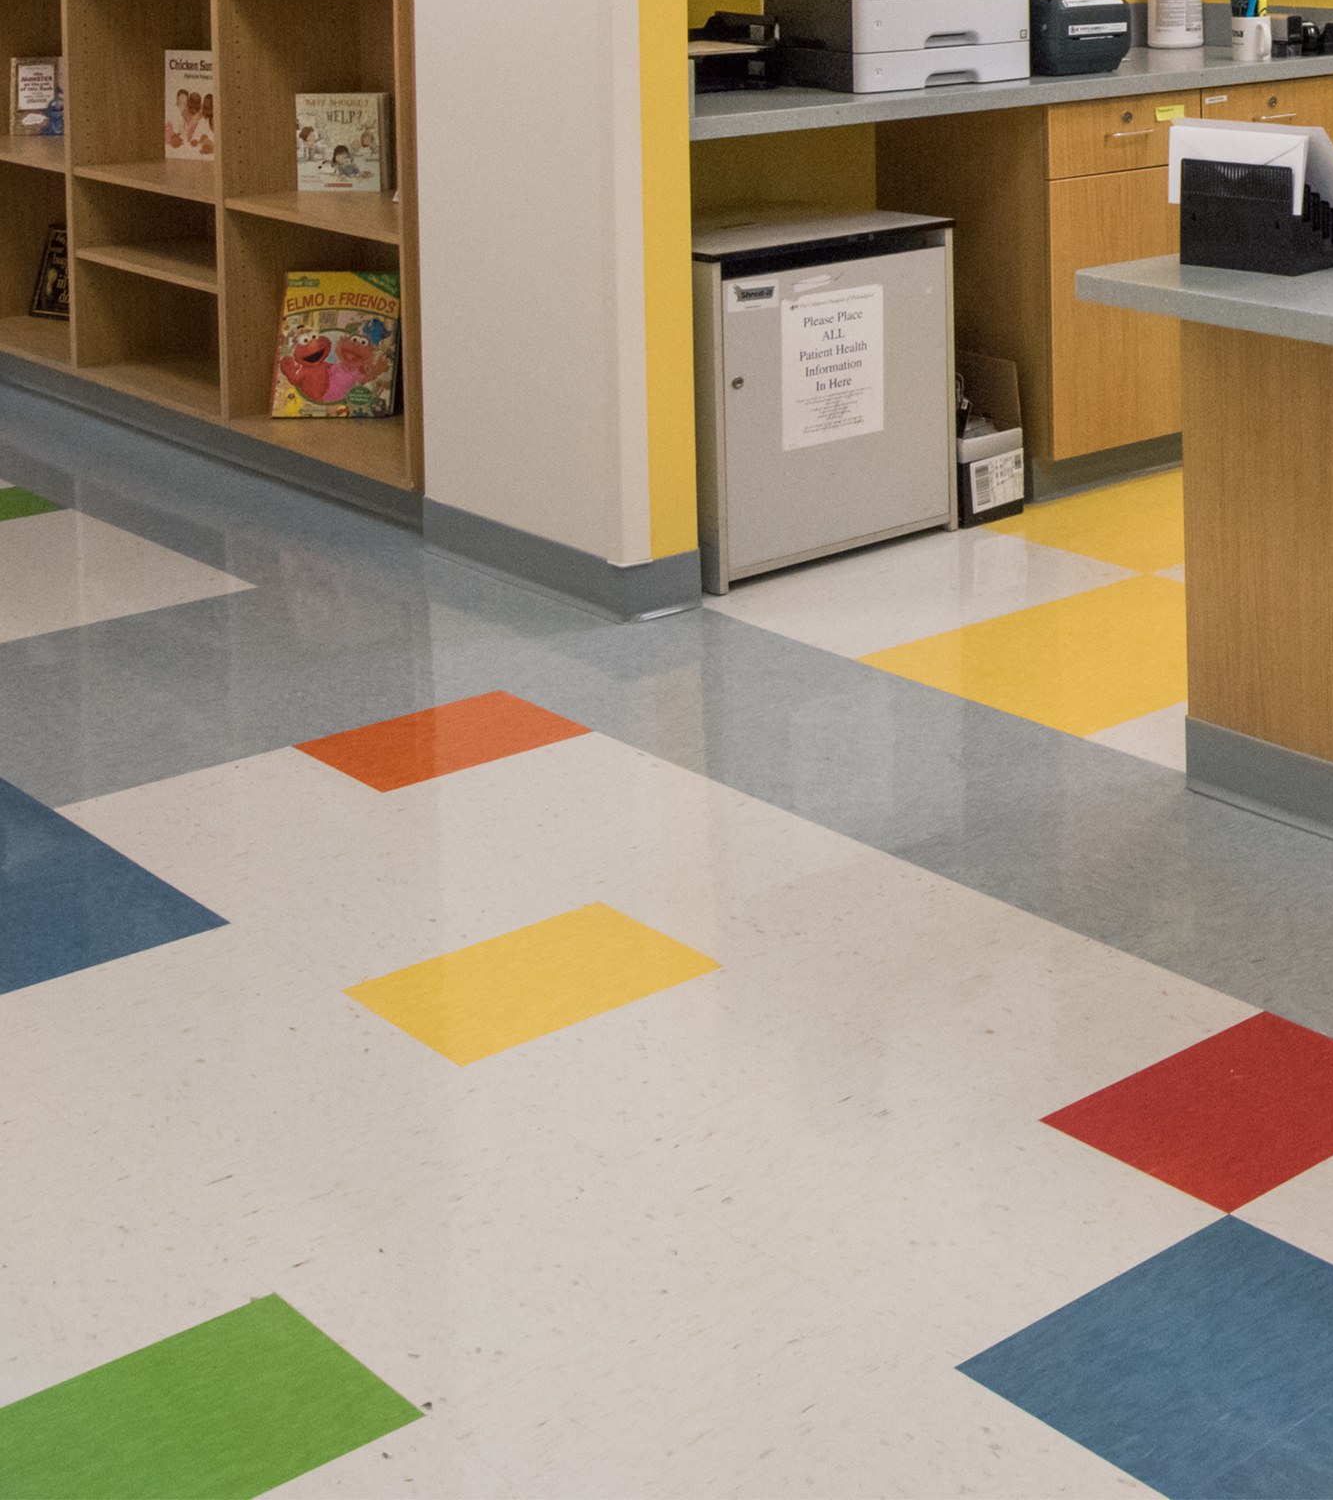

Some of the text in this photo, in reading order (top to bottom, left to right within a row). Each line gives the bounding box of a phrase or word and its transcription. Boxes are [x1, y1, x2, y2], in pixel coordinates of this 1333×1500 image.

[326, 110, 362, 124] HELP?
[741, 289, 773, 299] Shred-it
[287, 292, 396, 313] ELMO & FRIENDS
[804, 311, 863, 327] Please Place
[822, 328, 845, 341] ALL
[800, 340, 867, 361] Patient Health
[805, 359, 862, 377] Information
[816, 378, 852, 391] In Here
